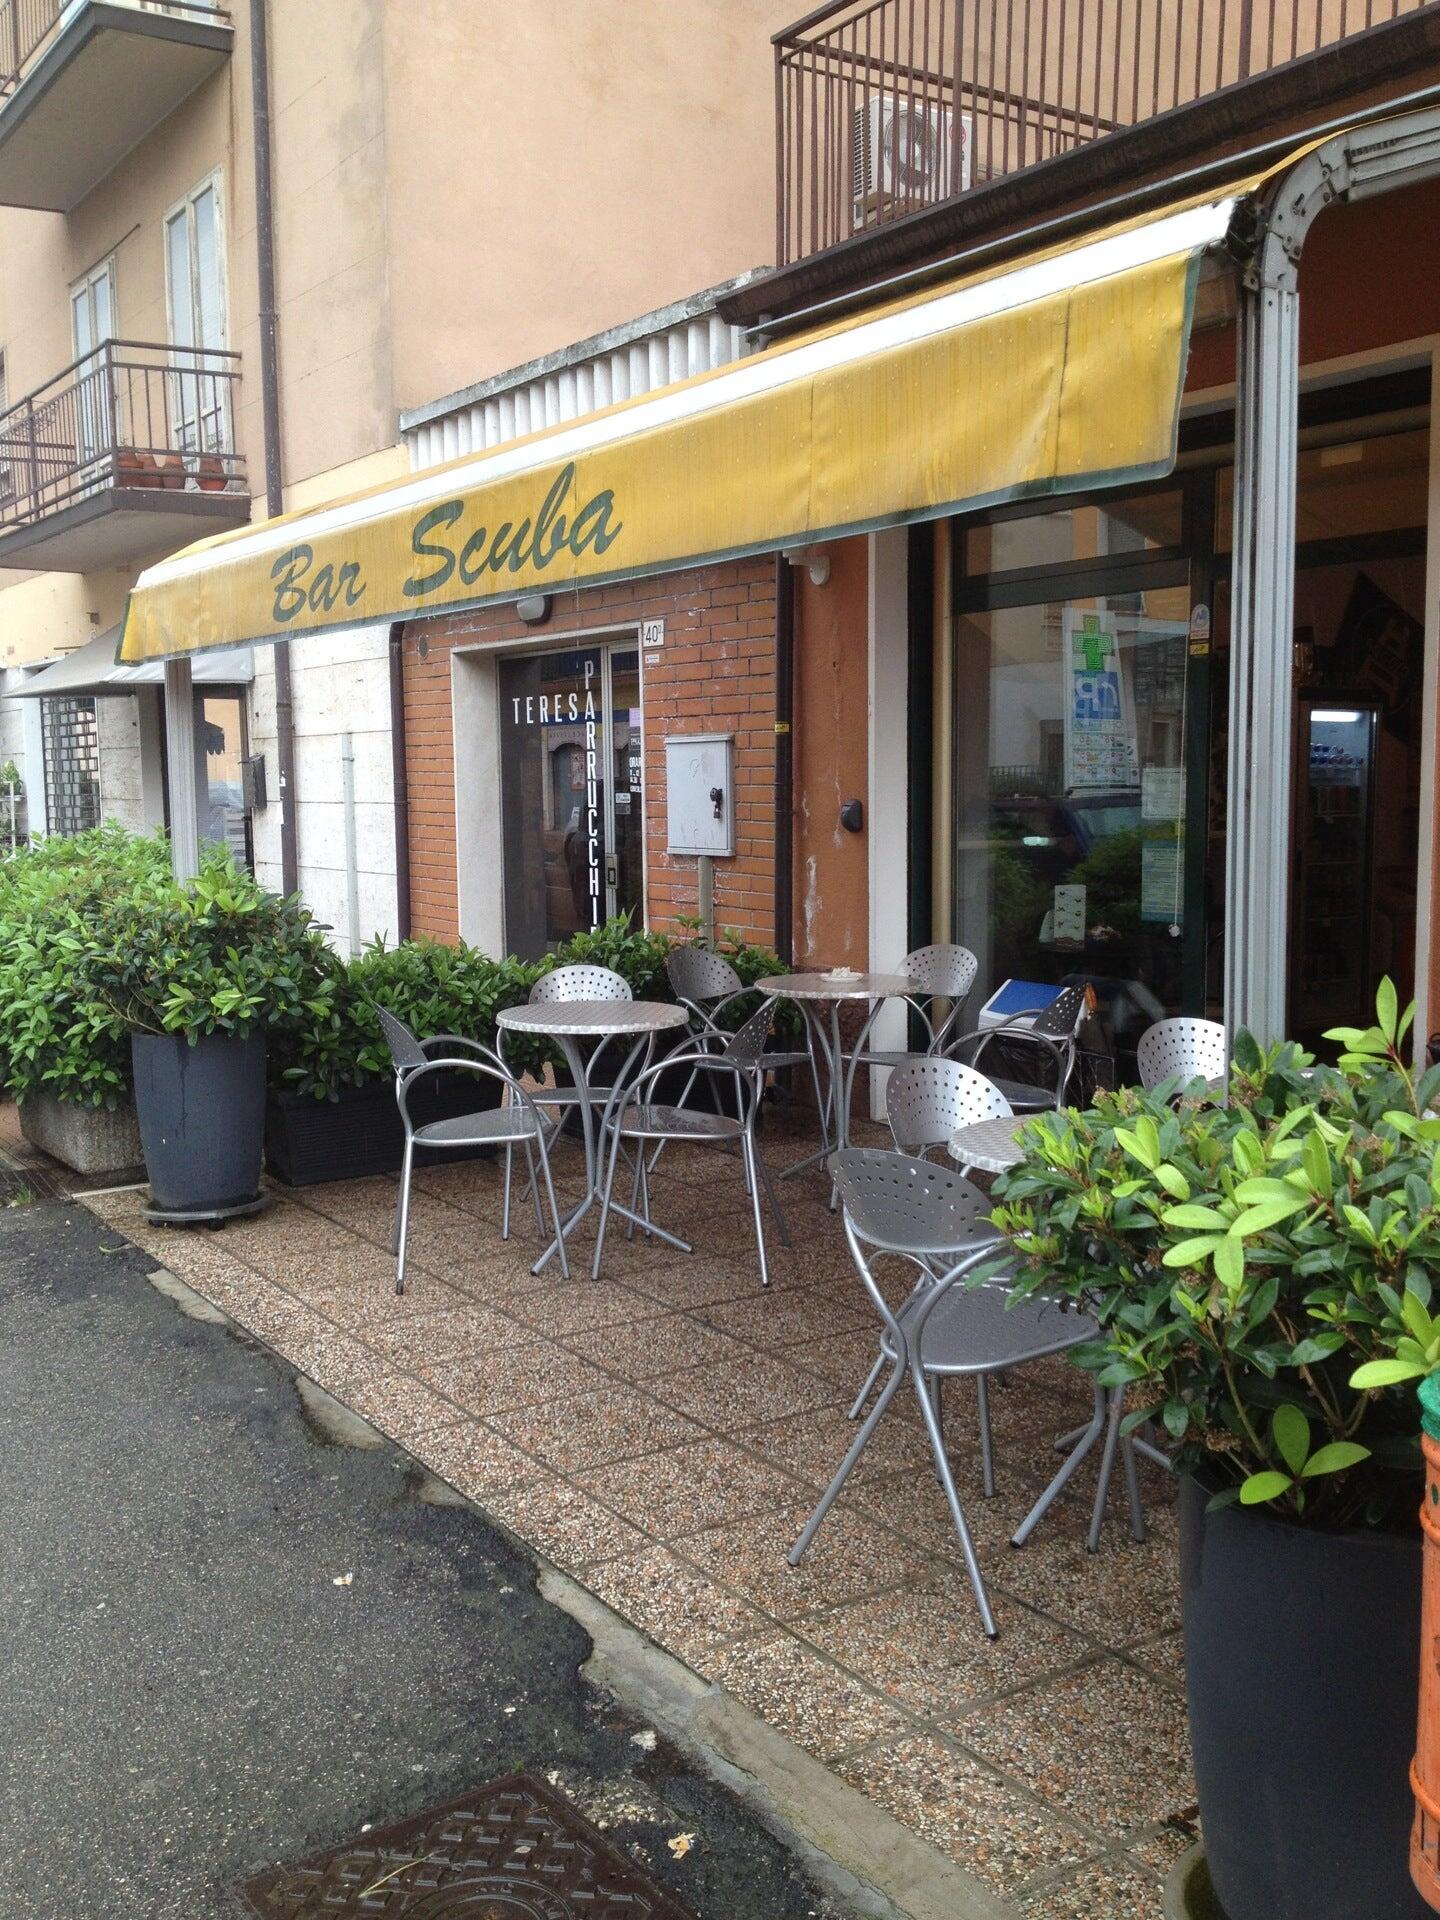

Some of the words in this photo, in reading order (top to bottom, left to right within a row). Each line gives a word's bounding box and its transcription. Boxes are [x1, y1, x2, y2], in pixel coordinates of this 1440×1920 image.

[270, 544, 366, 623] Bar
[403, 463, 623, 597] Scuba
[512, 691, 596, 724] TERESA
[584, 660, 600, 935] PARRUCCHI
